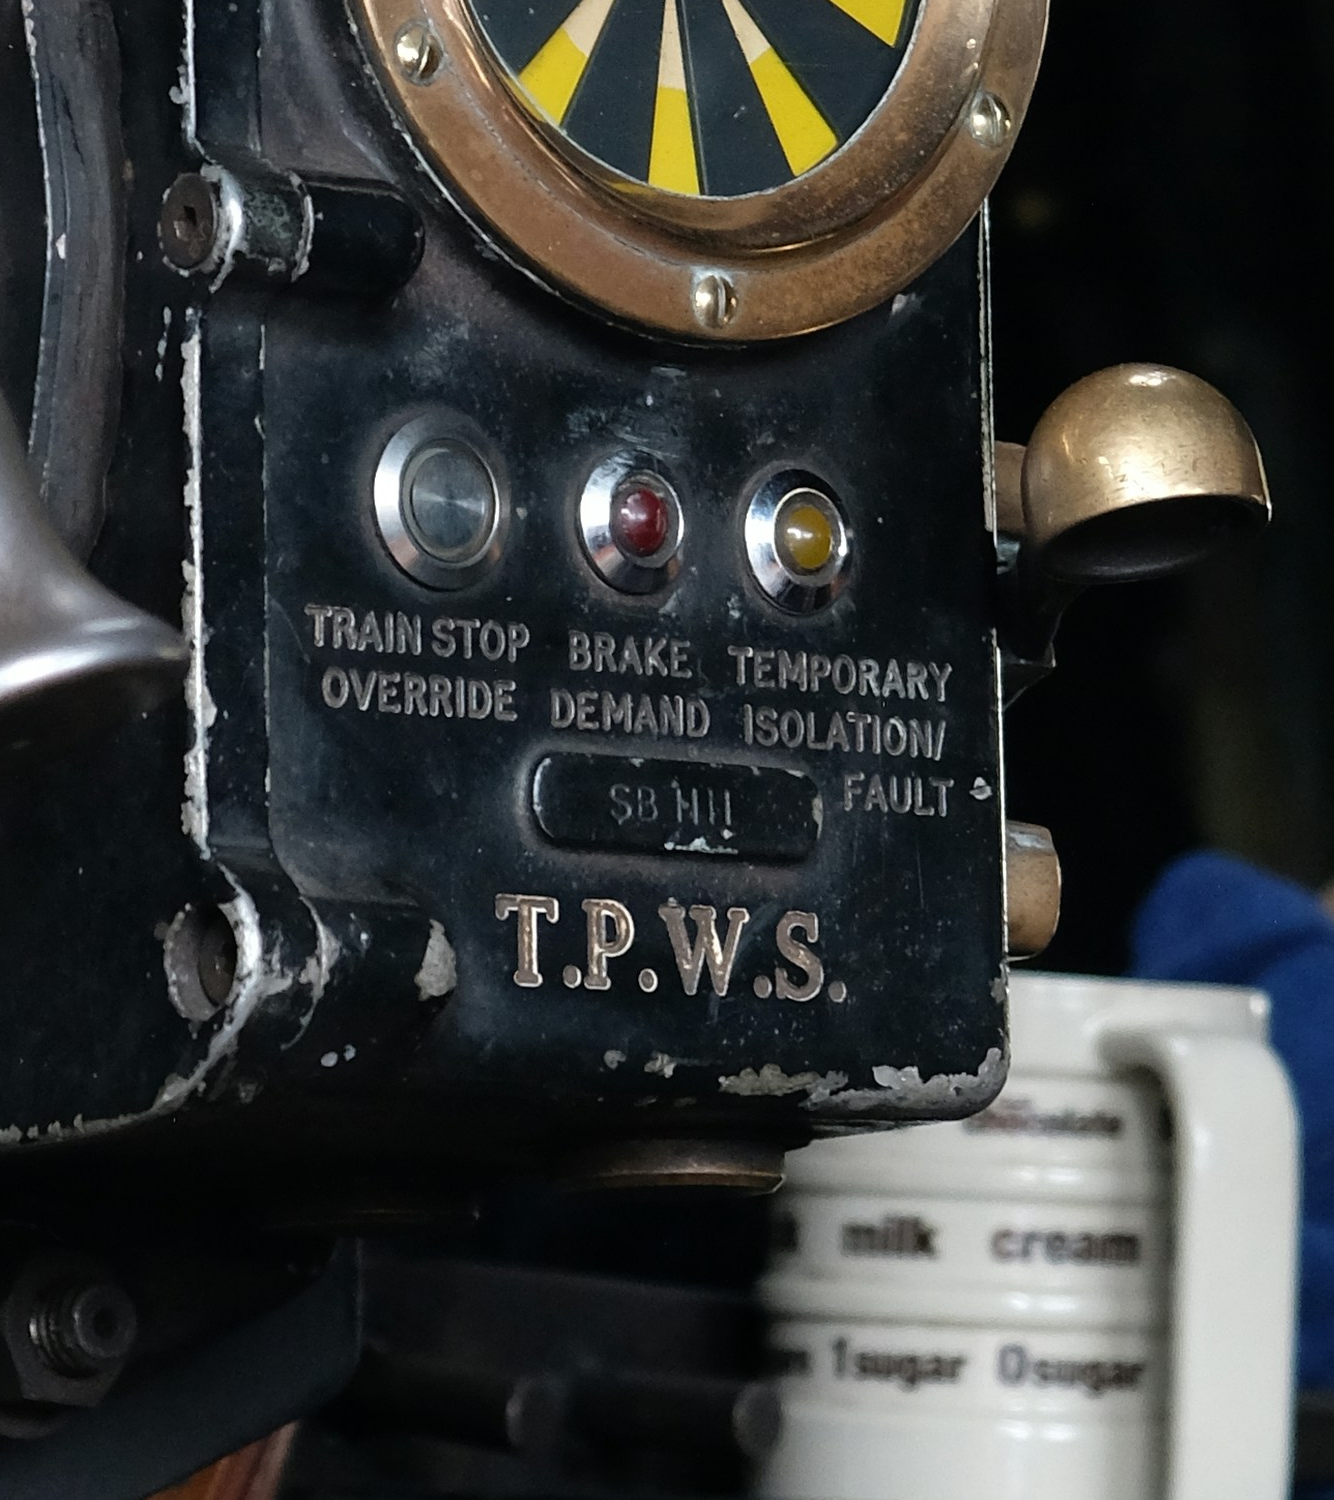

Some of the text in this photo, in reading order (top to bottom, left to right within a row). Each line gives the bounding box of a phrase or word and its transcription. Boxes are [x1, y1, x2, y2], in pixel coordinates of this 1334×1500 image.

[304, 603, 530, 664] TRAIN STOP
[568, 629, 694, 680] BRAKE
[321, 665, 518, 723] OVERRIDE
[727, 645, 953, 702] TEMPORARY
[550, 687, 711, 738] DEMAND
[742, 702, 948, 762] ISOLATION/
[843, 771, 955, 818] FAULT
[494, 892, 848, 1003] T.P.W.S.
[840, 1213, 938, 1258] milk
[989, 1227, 1141, 1265] cream
